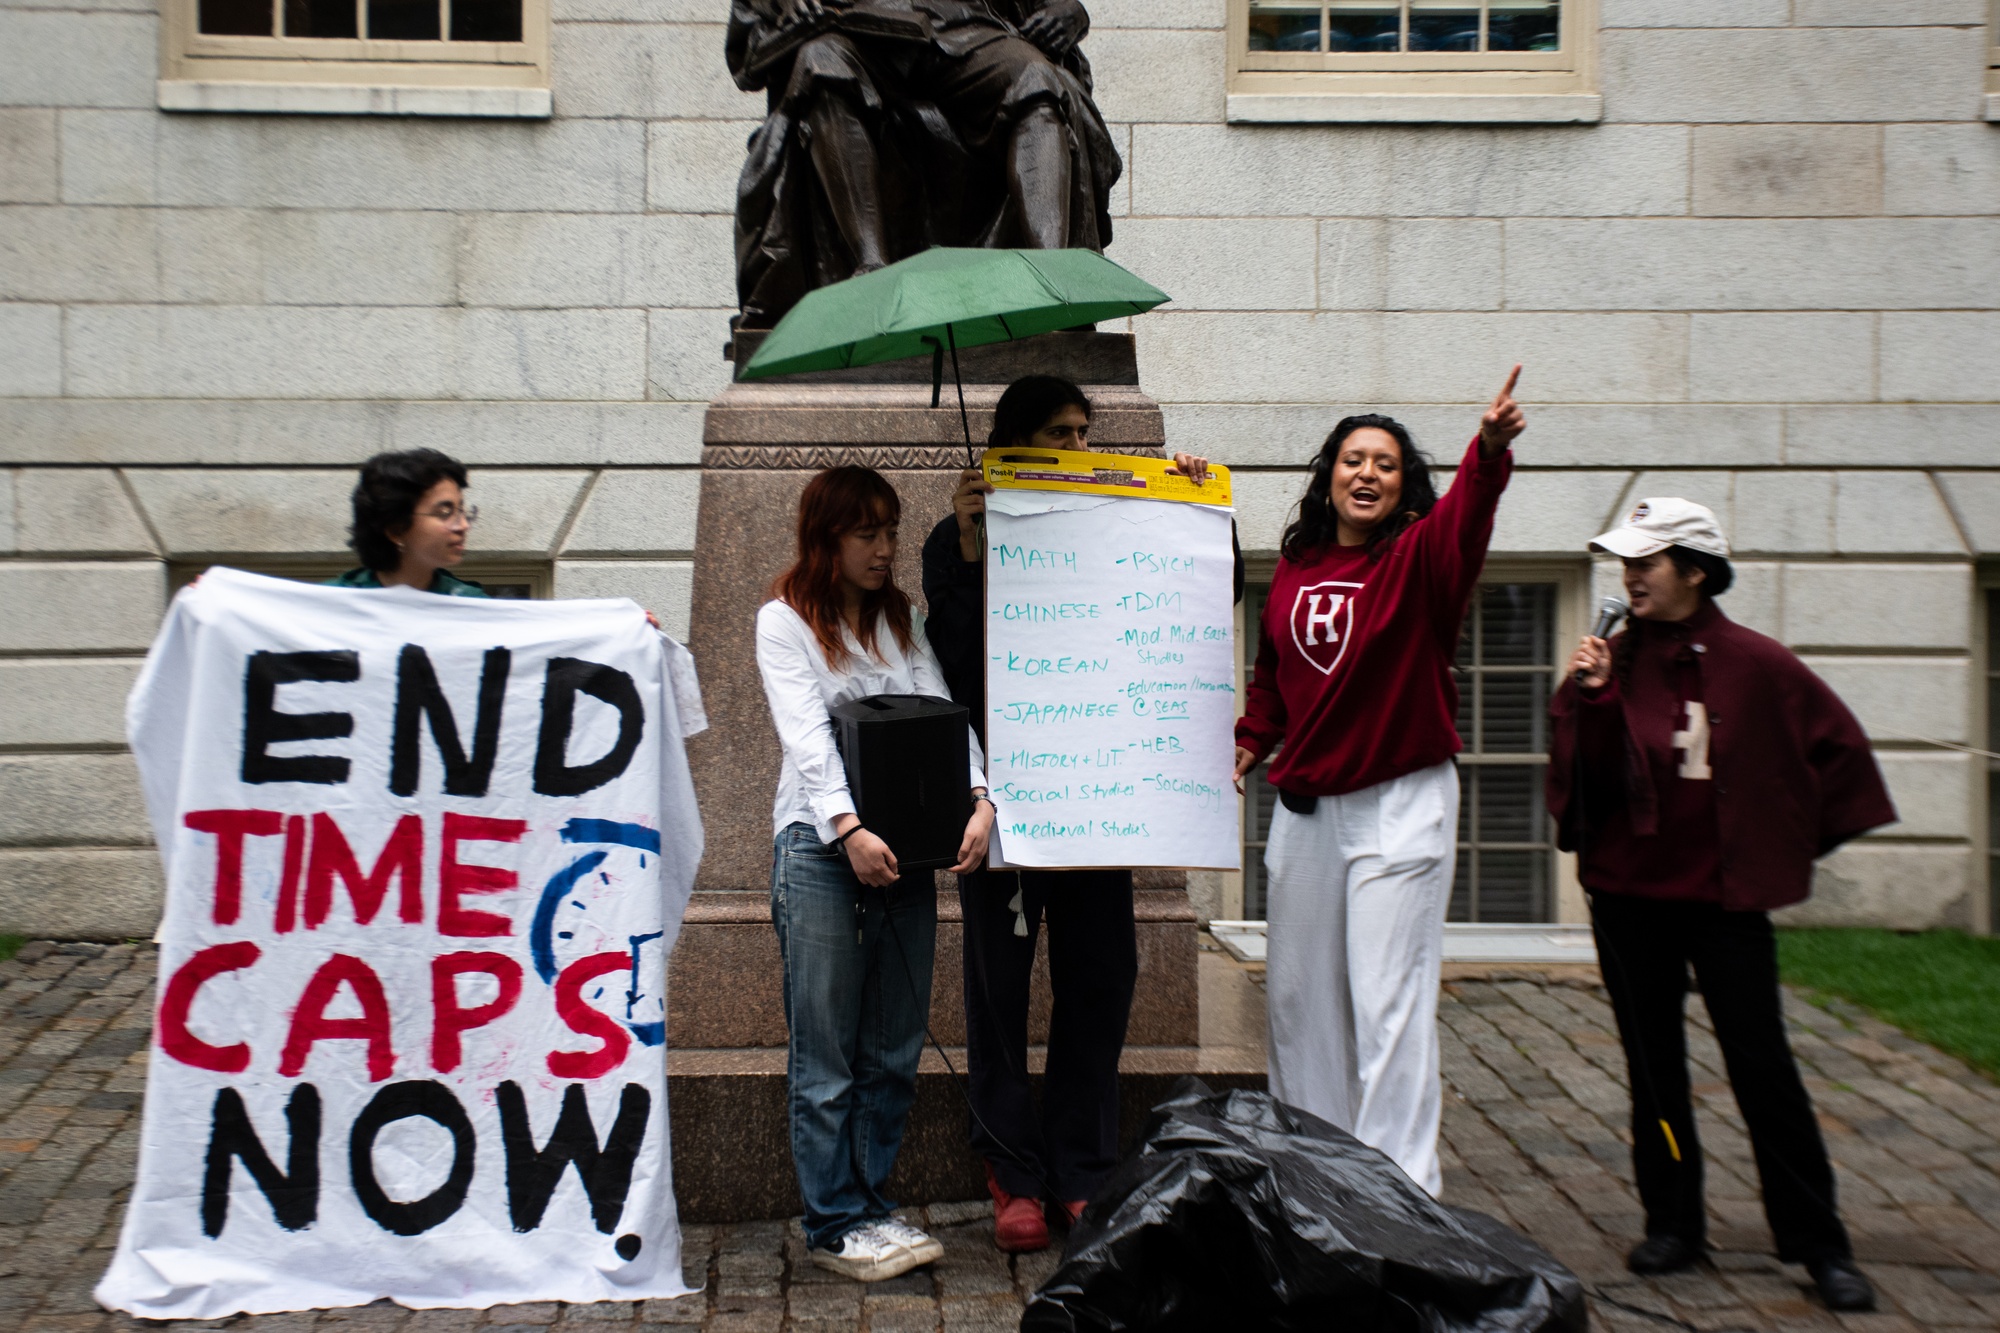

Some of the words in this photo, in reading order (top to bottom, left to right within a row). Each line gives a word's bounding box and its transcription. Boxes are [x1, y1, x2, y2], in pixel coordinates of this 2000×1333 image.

[990, 468, 1014, 477] Post-it
[1305, 593, 1345, 646] H
[1137, 649, 1184, 666] Studies
[239, 641, 646, 798] END
[1154, 699, 1190, 715] SEAS
[1079, 784, 1135, 801] Studies
[1101, 820, 1151, 839] Studies
[182, 808, 533, 938] TIME
[160, 940, 634, 1083] CAPS
[200, 1078, 652, 1263] NOW.
